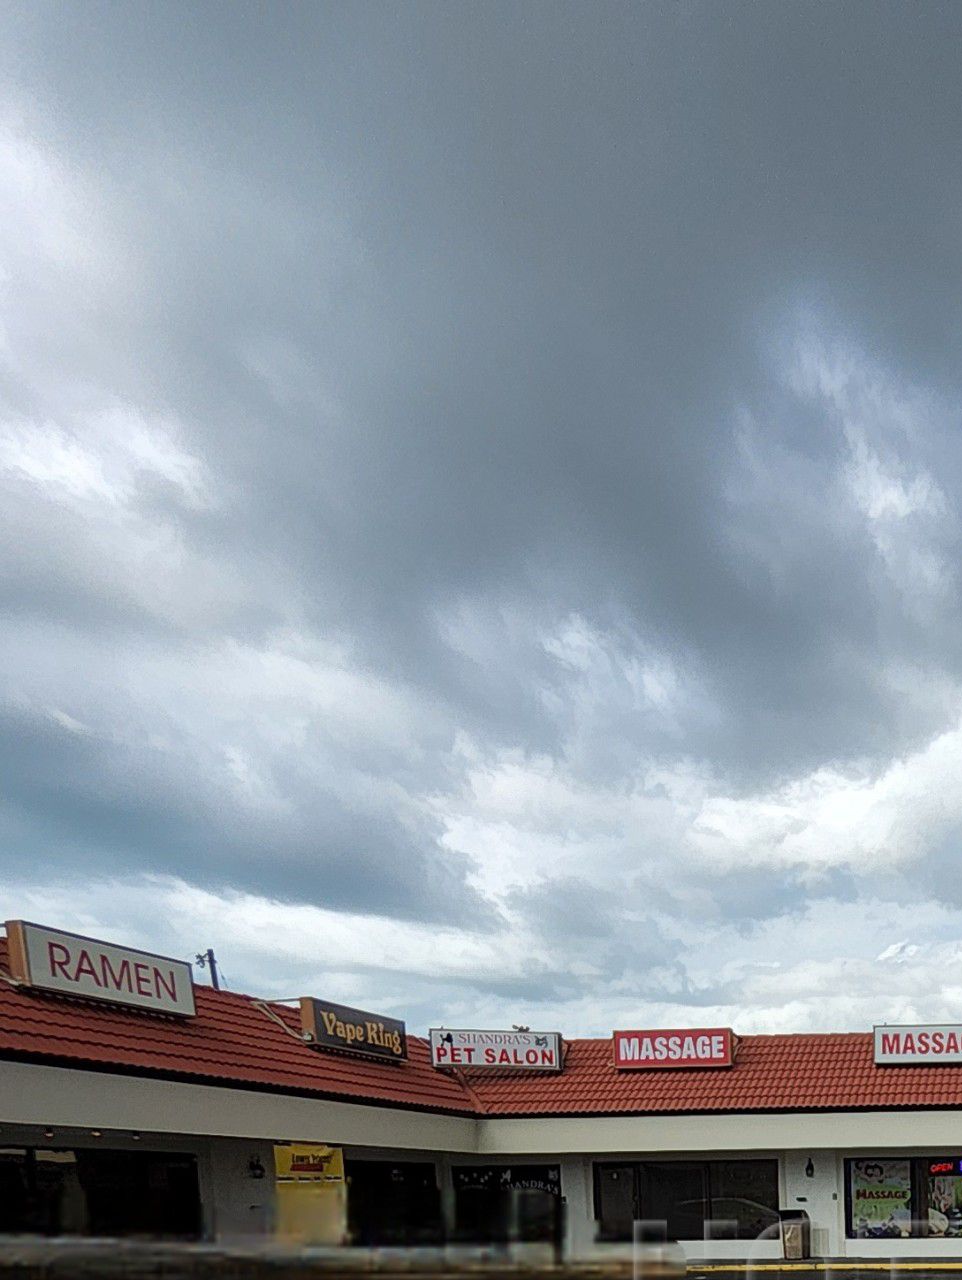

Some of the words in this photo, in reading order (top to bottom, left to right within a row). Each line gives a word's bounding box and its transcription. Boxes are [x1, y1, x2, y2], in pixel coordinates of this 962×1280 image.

[47, 941, 178, 1003] RAMEN
[319, 1010, 364, 1044] Vape
[365, 1021, 402, 1055] King
[457, 1033, 532, 1047] SHANDRA'S
[435, 1048, 474, 1064] PET
[484, 1048, 555, 1065] SALON
[618, 1035, 725, 1061] MASSAGE
[930, 1162, 953, 1173] OPEN
[856, 1188, 908, 1200] MASSAGE
